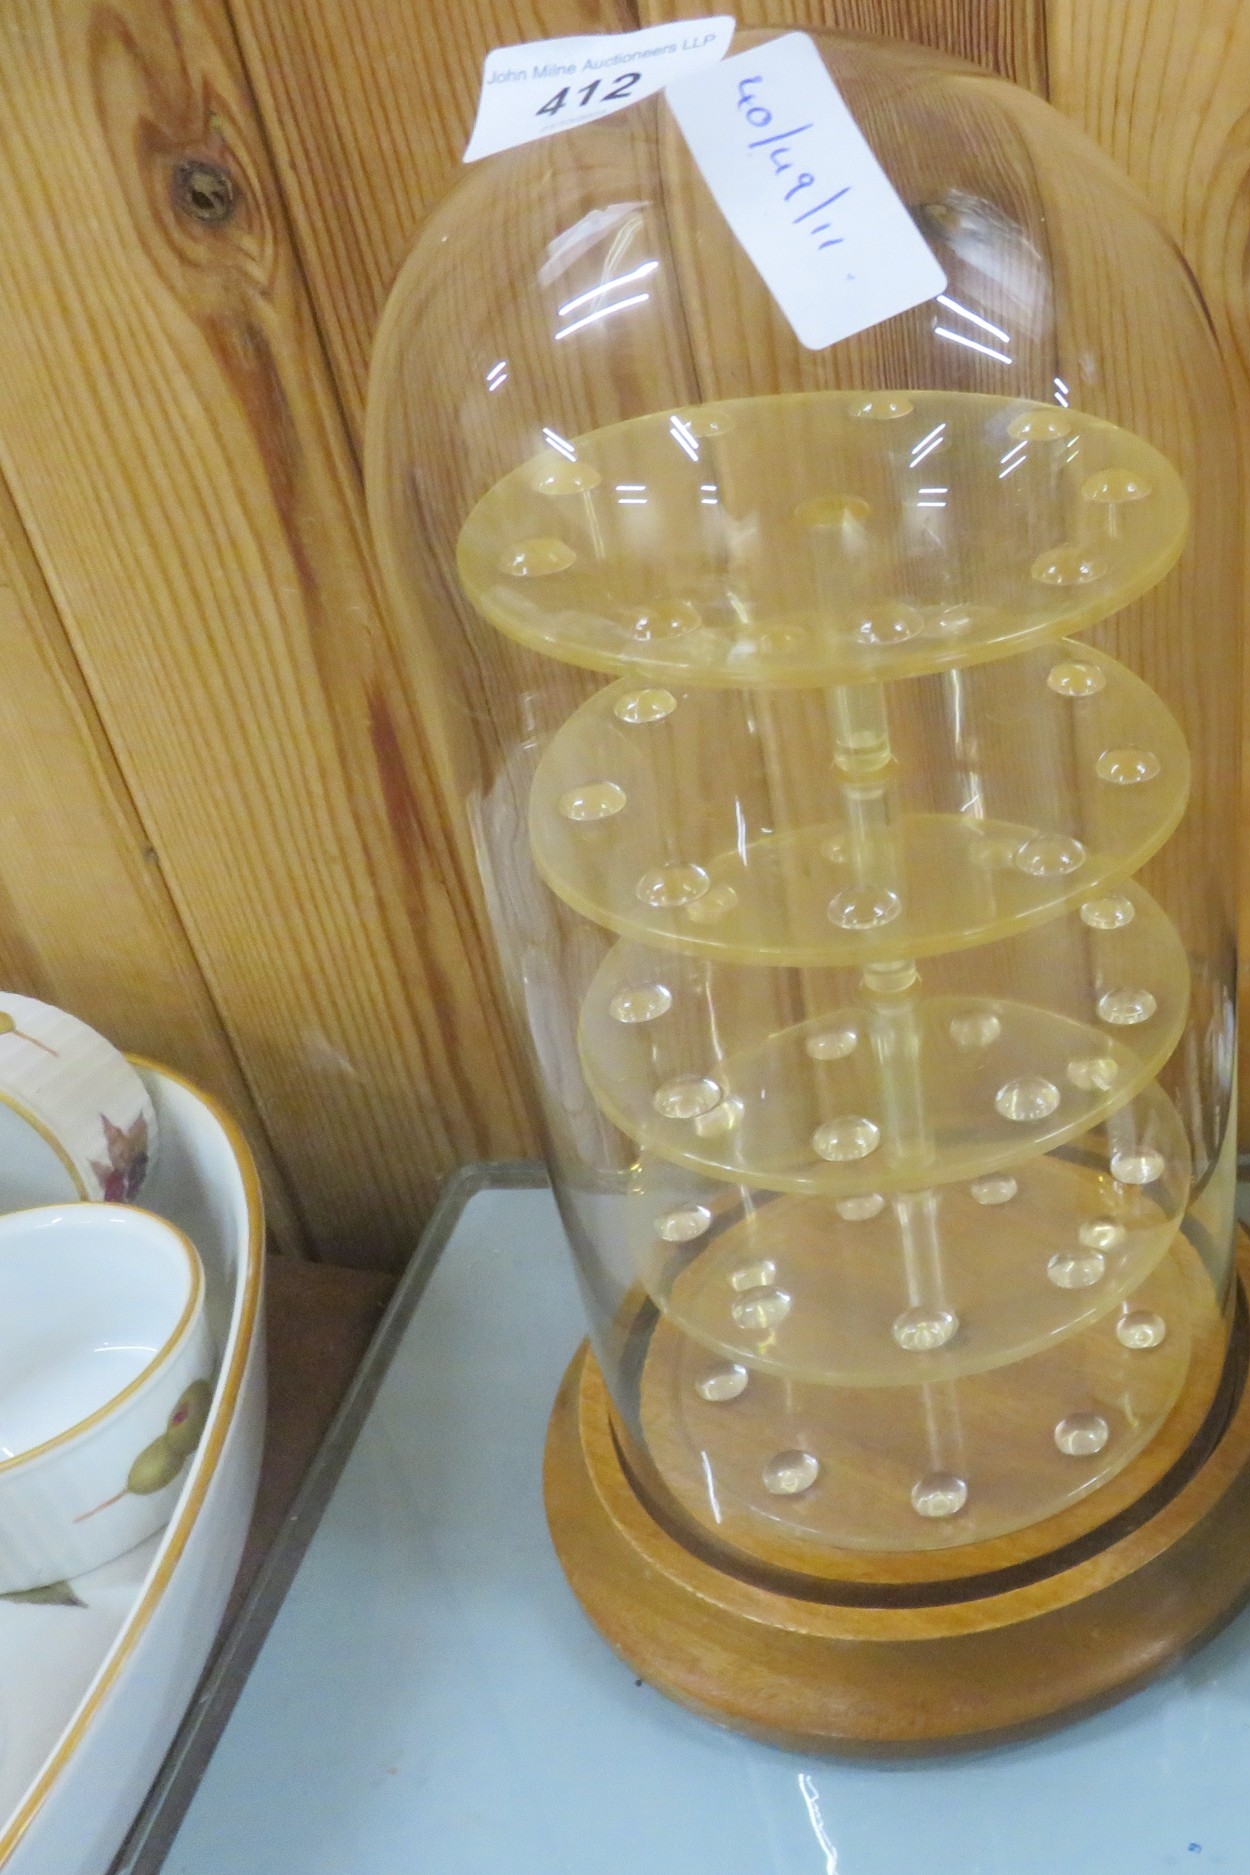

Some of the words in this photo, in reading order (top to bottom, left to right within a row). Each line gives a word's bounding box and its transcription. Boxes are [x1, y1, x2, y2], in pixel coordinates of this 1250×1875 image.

[487, 68, 527, 85] John
[532, 64, 577, 81] Milne
[581, 46, 678, 71] Auctioneers
[681, 34, 717, 50] LLP
[535, 72, 643, 117] 412
